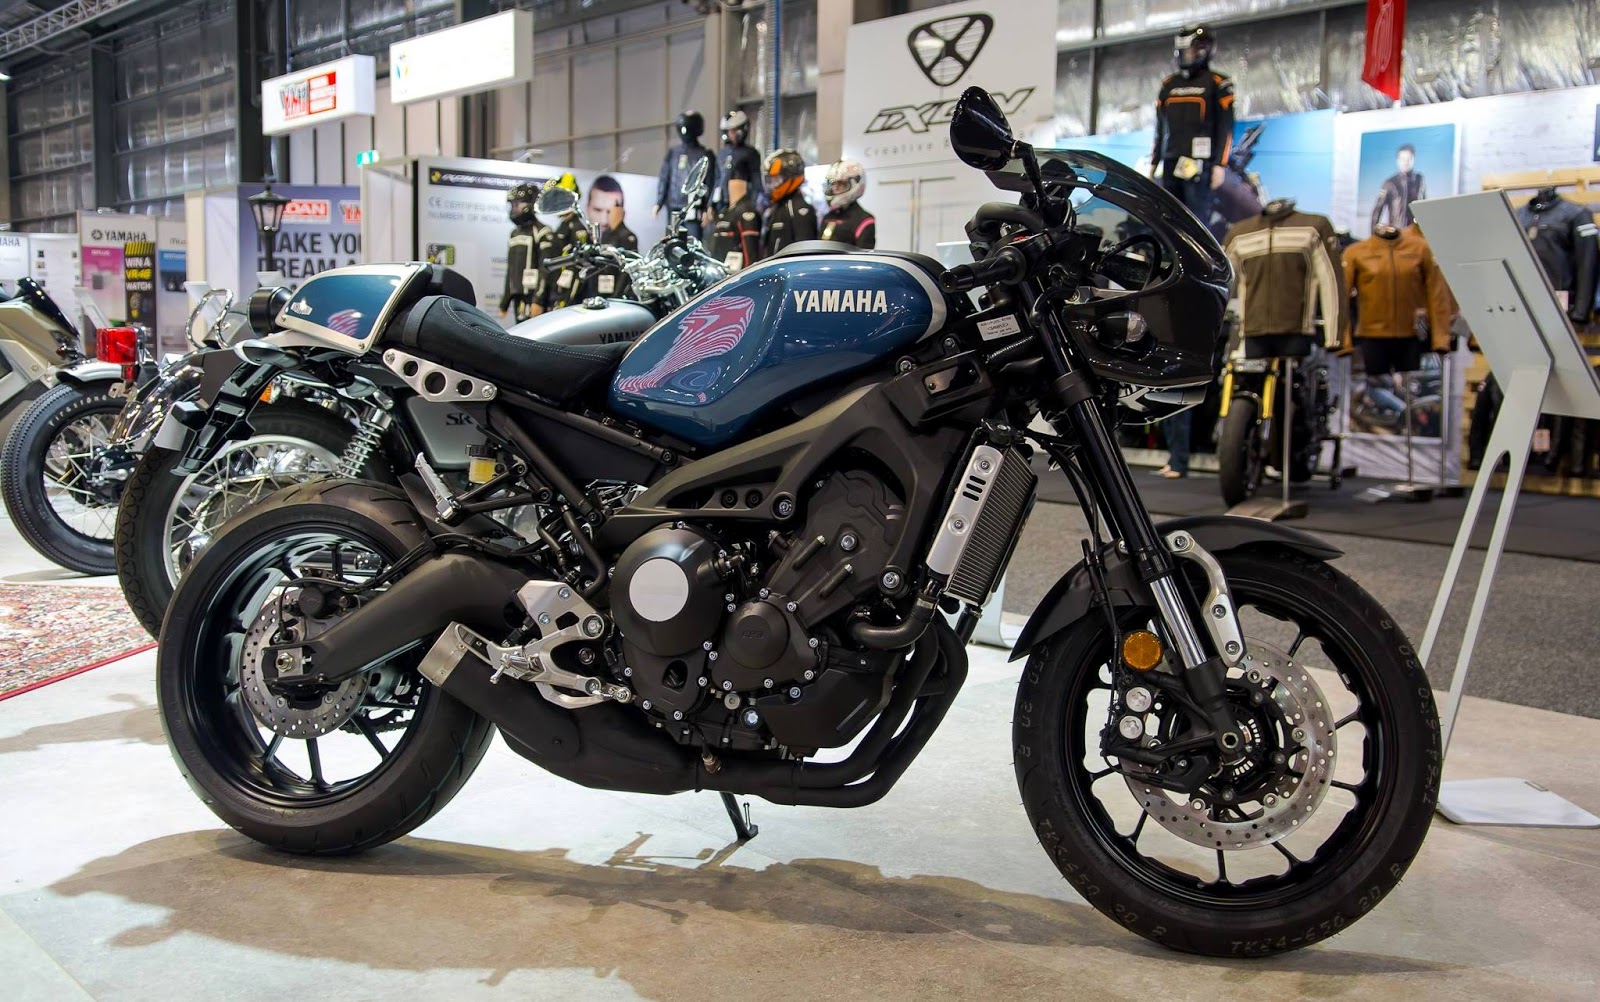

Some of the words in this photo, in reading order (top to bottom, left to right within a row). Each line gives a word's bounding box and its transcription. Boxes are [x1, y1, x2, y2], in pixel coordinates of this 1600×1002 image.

[285, 201, 327, 215] OAN
[104, 230, 147, 242] YAMAHA
[793, 289, 888, 313] YAMAHA
